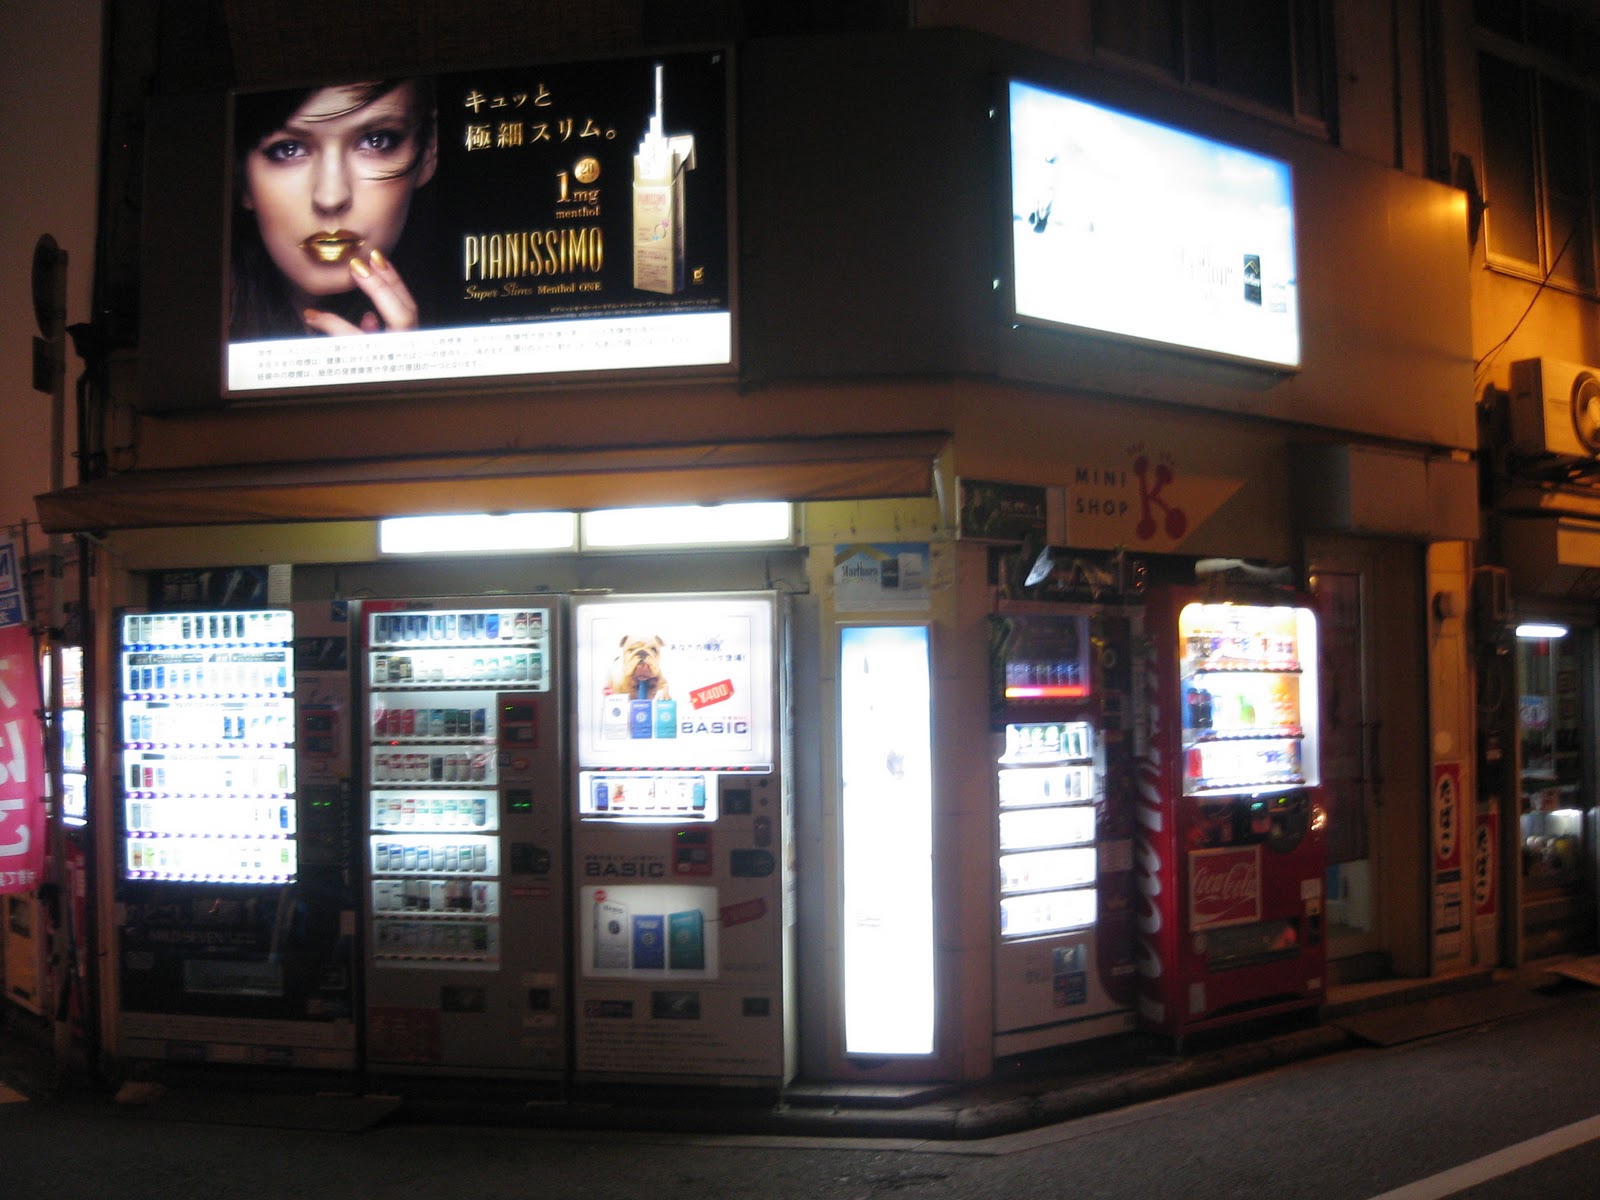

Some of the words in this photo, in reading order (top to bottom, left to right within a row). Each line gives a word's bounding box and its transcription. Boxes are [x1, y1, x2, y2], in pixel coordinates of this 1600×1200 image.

[465, 84, 552, 113] キュッと
[465, 117, 616, 151] 極細スリム。
[556, 206, 600, 219] menthol
[465, 227, 603, 281] PIANISSIMO
[464, 286, 497, 301] Super
[501, 281, 532, 297] Slims
[538, 284, 576, 296] Menthol
[579, 282, 602, 293] ONE
[1076, 467, 1129, 486] MINI
[1076, 498, 1129, 518] SHOP
[681, 722, 748, 735] BASIC
[585, 863, 665, 878] BASIC
